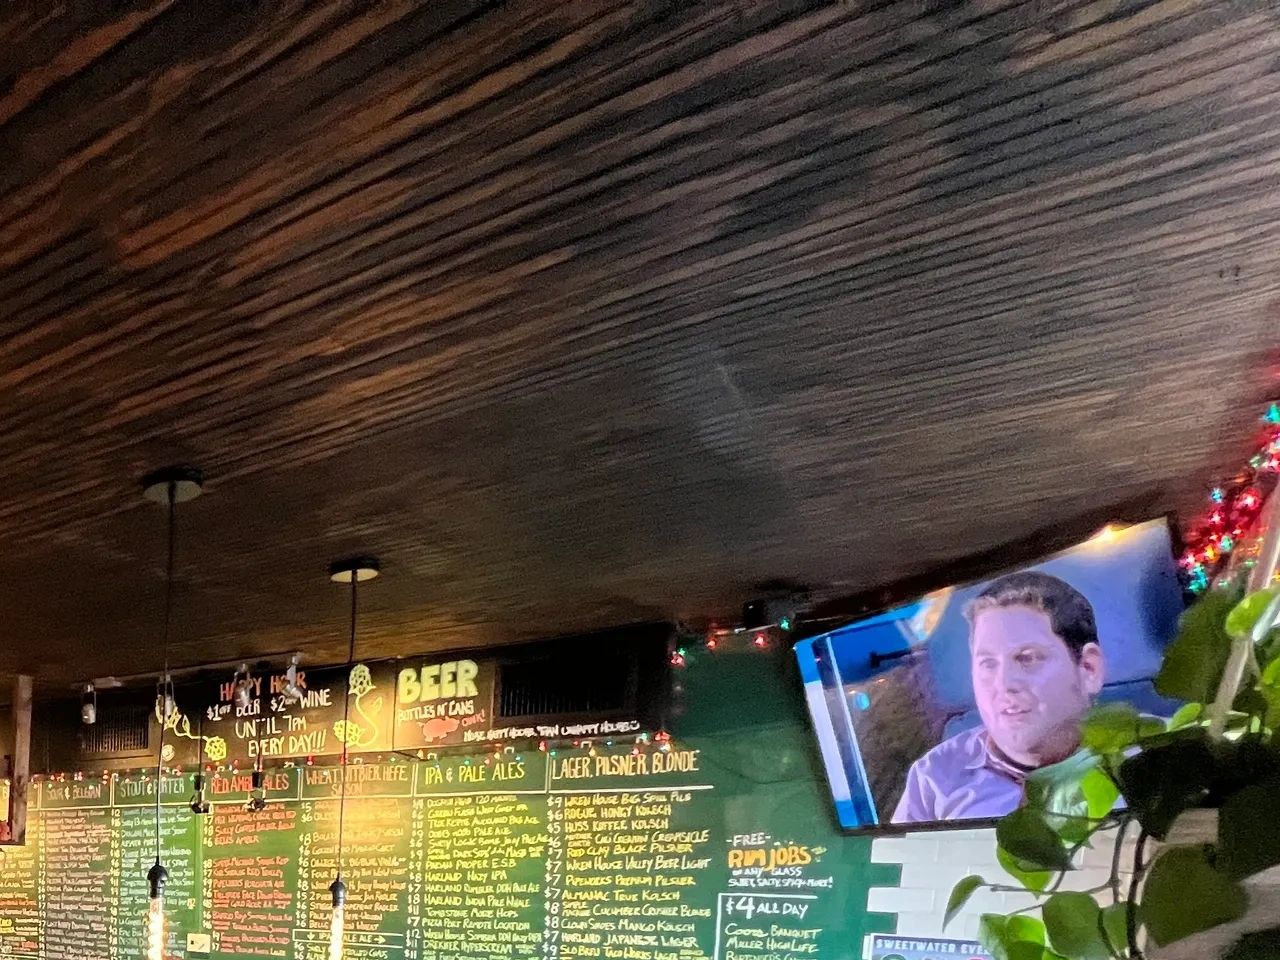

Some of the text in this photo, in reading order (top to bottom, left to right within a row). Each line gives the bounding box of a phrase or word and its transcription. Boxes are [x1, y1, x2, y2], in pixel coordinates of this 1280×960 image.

[396, 659, 479, 705] BEER
[299, 689, 332, 709] WINE
[397, 702, 436, 724] BOTTLES
[448, 699, 475, 718] CANS
[287, 715, 307, 731] 7PM
[248, 729, 327, 757] EVERY DAY!!!
[652, 750, 700, 773] BLONDE
[425, 766, 443, 785] IPA
[458, 765, 486, 782] PALE
[492, 762, 525, 781] ALES
[120, 778, 145, 798] STOUT
[262, 775, 289, 792] ALES
[547, 796, 563, 808] $9
[564, 796, 591, 807] WREN
[592, 794, 619, 805] HOUSE
[621, 794, 641, 805] BIG
[547, 810, 563, 822] $6
[601, 806, 632, 818] HONEY
[547, 822, 561, 833] $5
[565, 820, 589, 832] HUSS
[548, 836, 561, 848] $6
[651, 829, 711, 843] CREAMSICLE
[548, 847, 563, 859] $7
[587, 846, 609, 858] CLAY
[613, 844, 647, 855] BLACK
[650, 844, 693, 853] PILSNER
[728, 846, 811, 871] RIM JOBS
[545, 855, 712, 873] $7 WREN HOUSE VALLEY BEER LIGHT
[744, 867, 803, 877] ANY GLASS
[424, 872, 462, 882] HARLAND
[467, 871, 488, 883] HAZY
[491, 870, 507, 880] IPA
[545, 874, 561, 886] $7
[615, 874, 652, 886] PREMIUM
[654, 875, 696, 887] PILSNER
[408, 883, 462, 893] $7 HARLAND
[544, 886, 638, 902] $7 ALMANAC TRUE
[424, 894, 461, 906] HARLAND
[726, 897, 808, 919] $4 ALL DAY
[544, 901, 559, 914] $8
[592, 903, 641, 916] CUCUMBER
[407, 917, 530, 930] $7 PIZZA PORT REMOTE LOCATION
[544, 916, 559, 929] $8
[618, 919, 655, 932] MANGO
[725, 923, 823, 939] COORS BANQUET
[543, 930, 700, 948] $7 HARLAND JAPANESE LAGER
[725, 936, 819, 953] MILLER HIGH LIFE
[876, 938, 955, 953] SWEETWATER
[542, 943, 558, 956] $9
[578, 945, 601, 956] BREW
